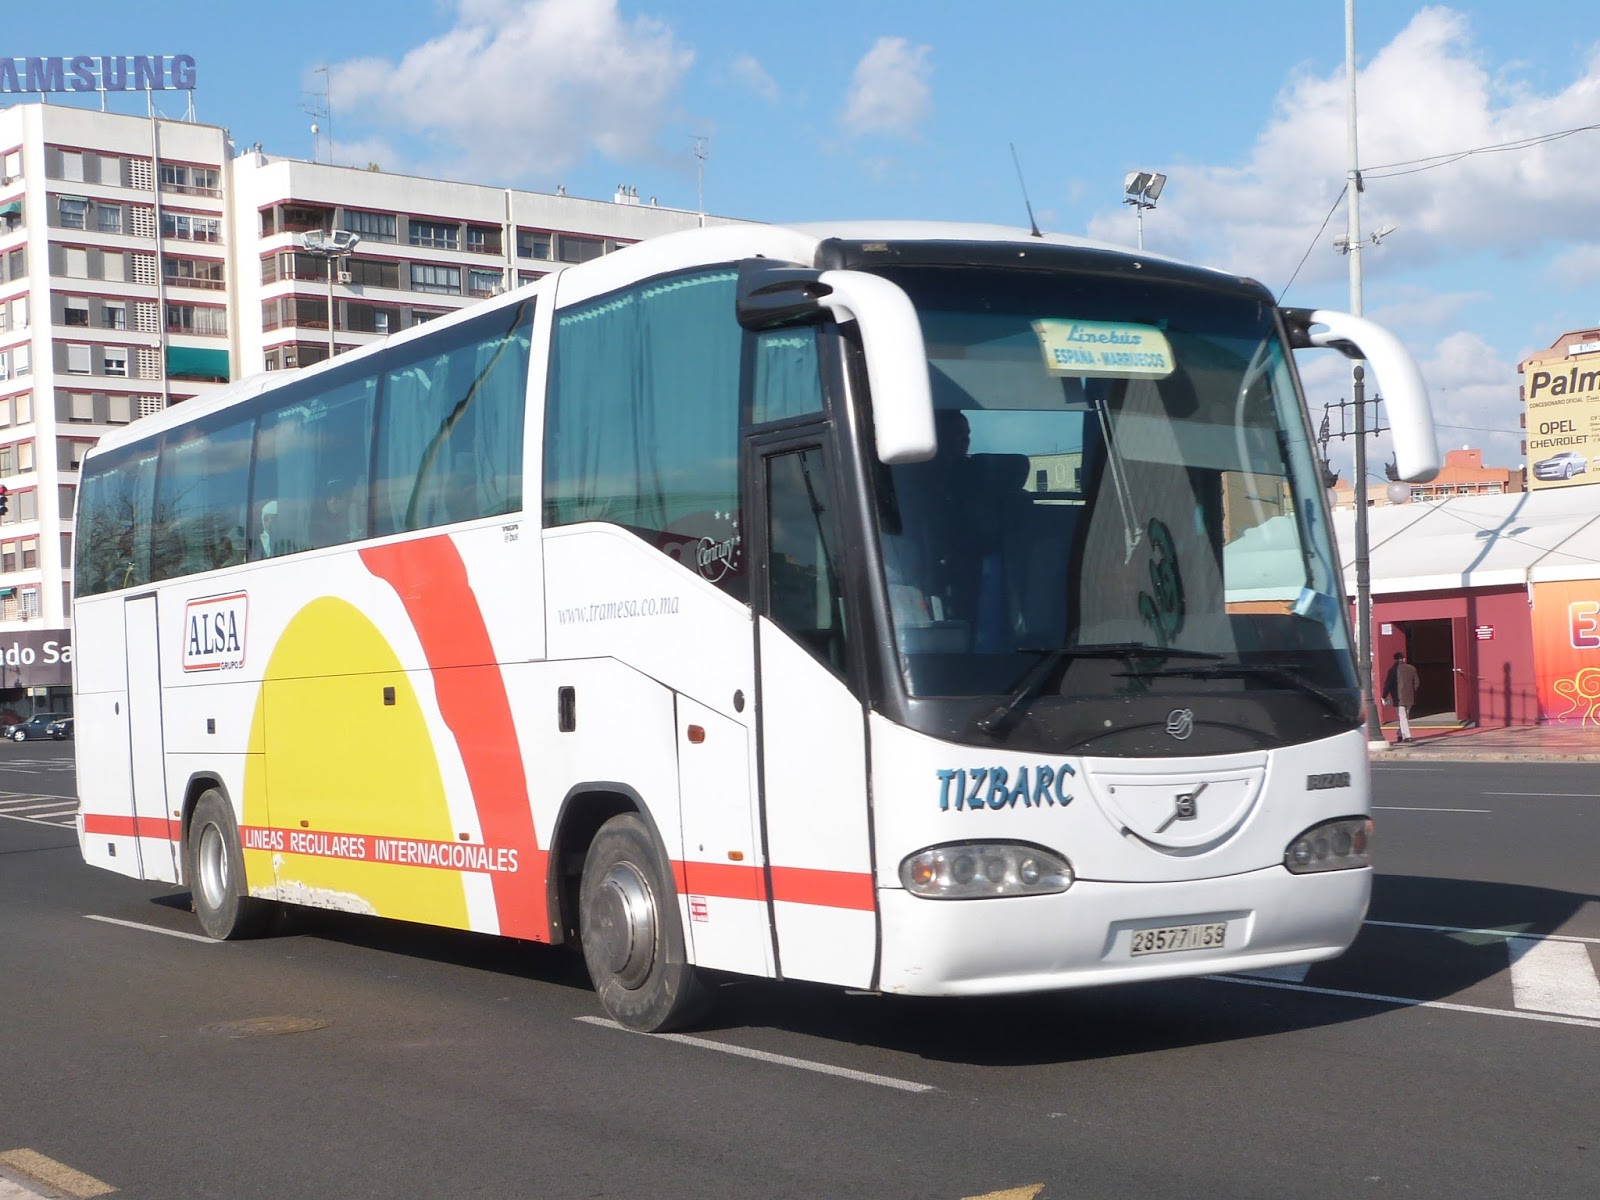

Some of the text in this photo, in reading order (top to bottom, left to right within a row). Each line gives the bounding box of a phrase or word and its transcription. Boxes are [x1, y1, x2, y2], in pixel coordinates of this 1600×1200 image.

[1054, 347, 1095, 364] ESPAÑA
[1103, 351, 1165, 368] MARRUECOS
[1529, 399, 1566, 409] CONCESIONARIO
[1539, 419, 1577, 435] OPEL
[1530, 434, 1589, 449] CHEVROLET
[558, 596, 680, 625] www.tramesa.co.ma
[188, 610, 241, 656] ALSA
[0, 642, 36, 666] do
[220, 661, 239, 670] GRUPO
[936, 763, 1077, 812] TIZBARC
[245, 829, 519, 873] LINEAS REGULARES INTERNACIONALES
